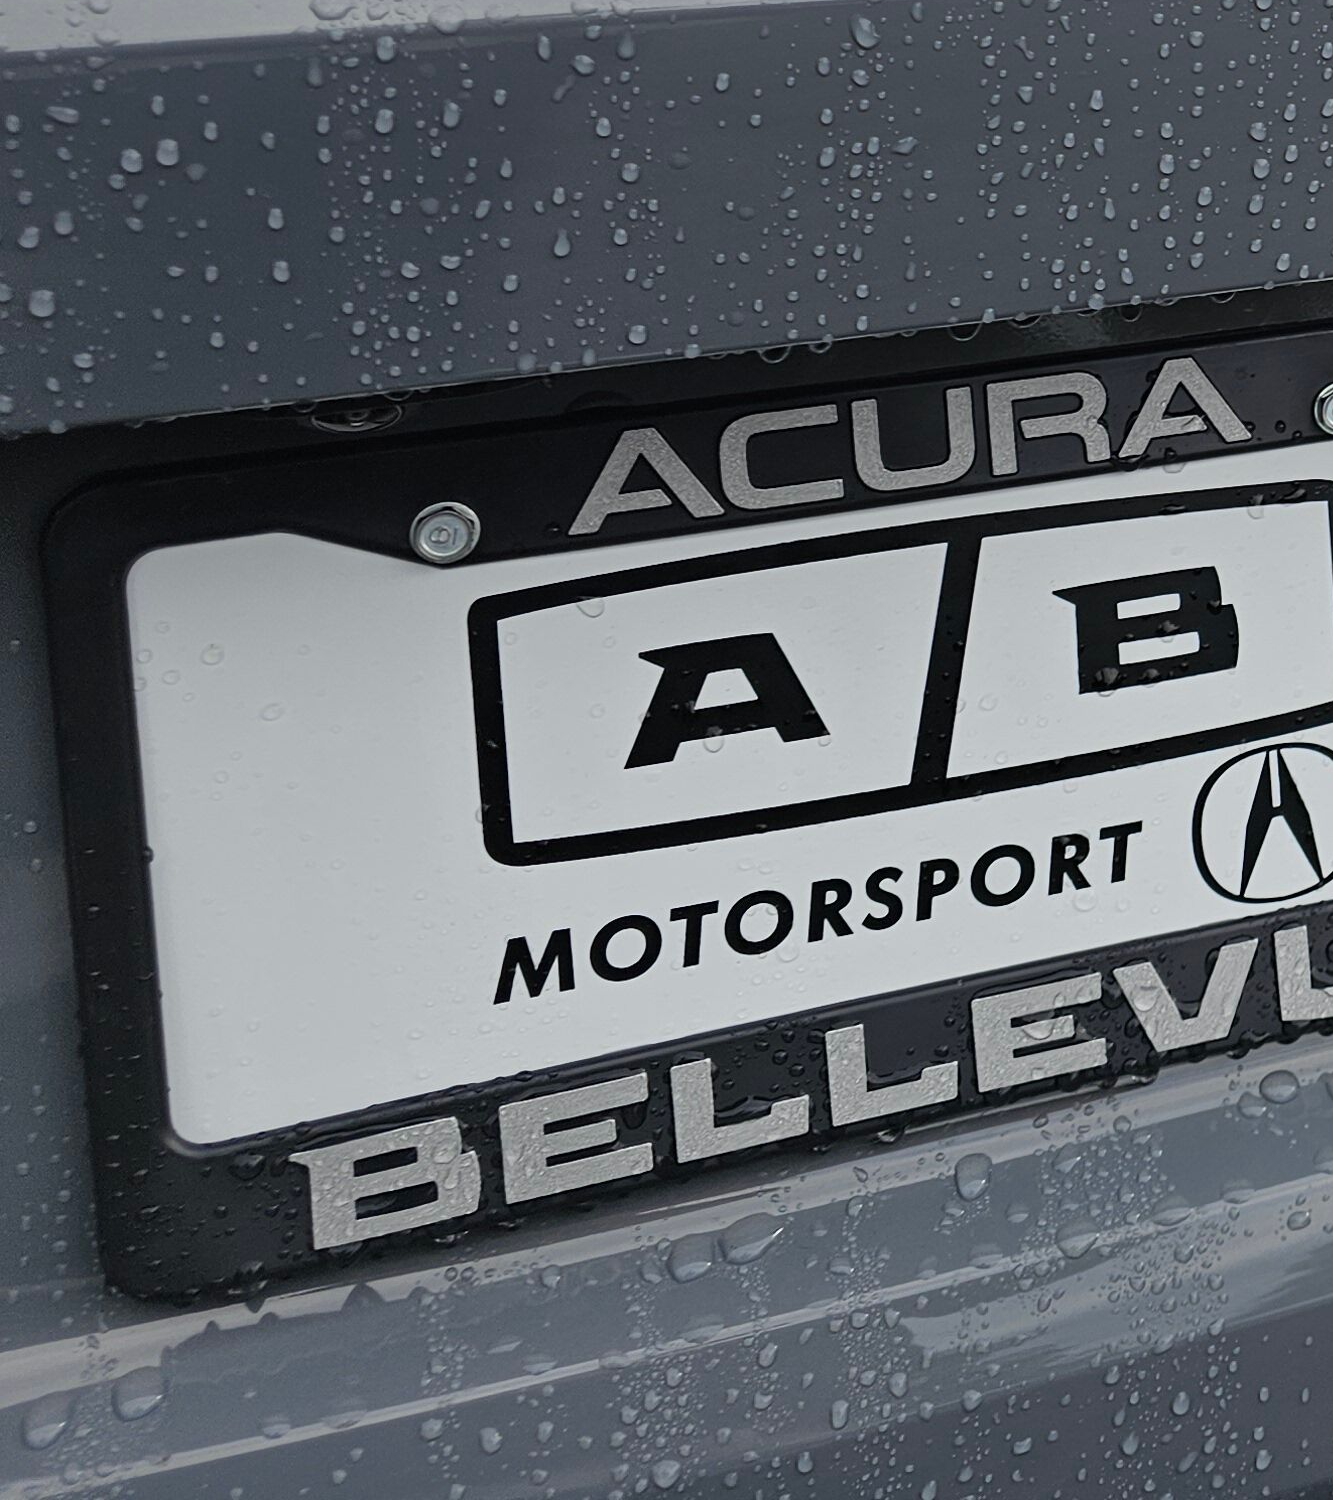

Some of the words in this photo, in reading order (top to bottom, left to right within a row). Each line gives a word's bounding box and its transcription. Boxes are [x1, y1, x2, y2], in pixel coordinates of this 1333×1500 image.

[567, 357, 1252, 537] ACURA
[623, 631, 831, 770] A
[1050, 565, 1240, 695] B
[493, 820, 1143, 1005] MOTORSPORT
